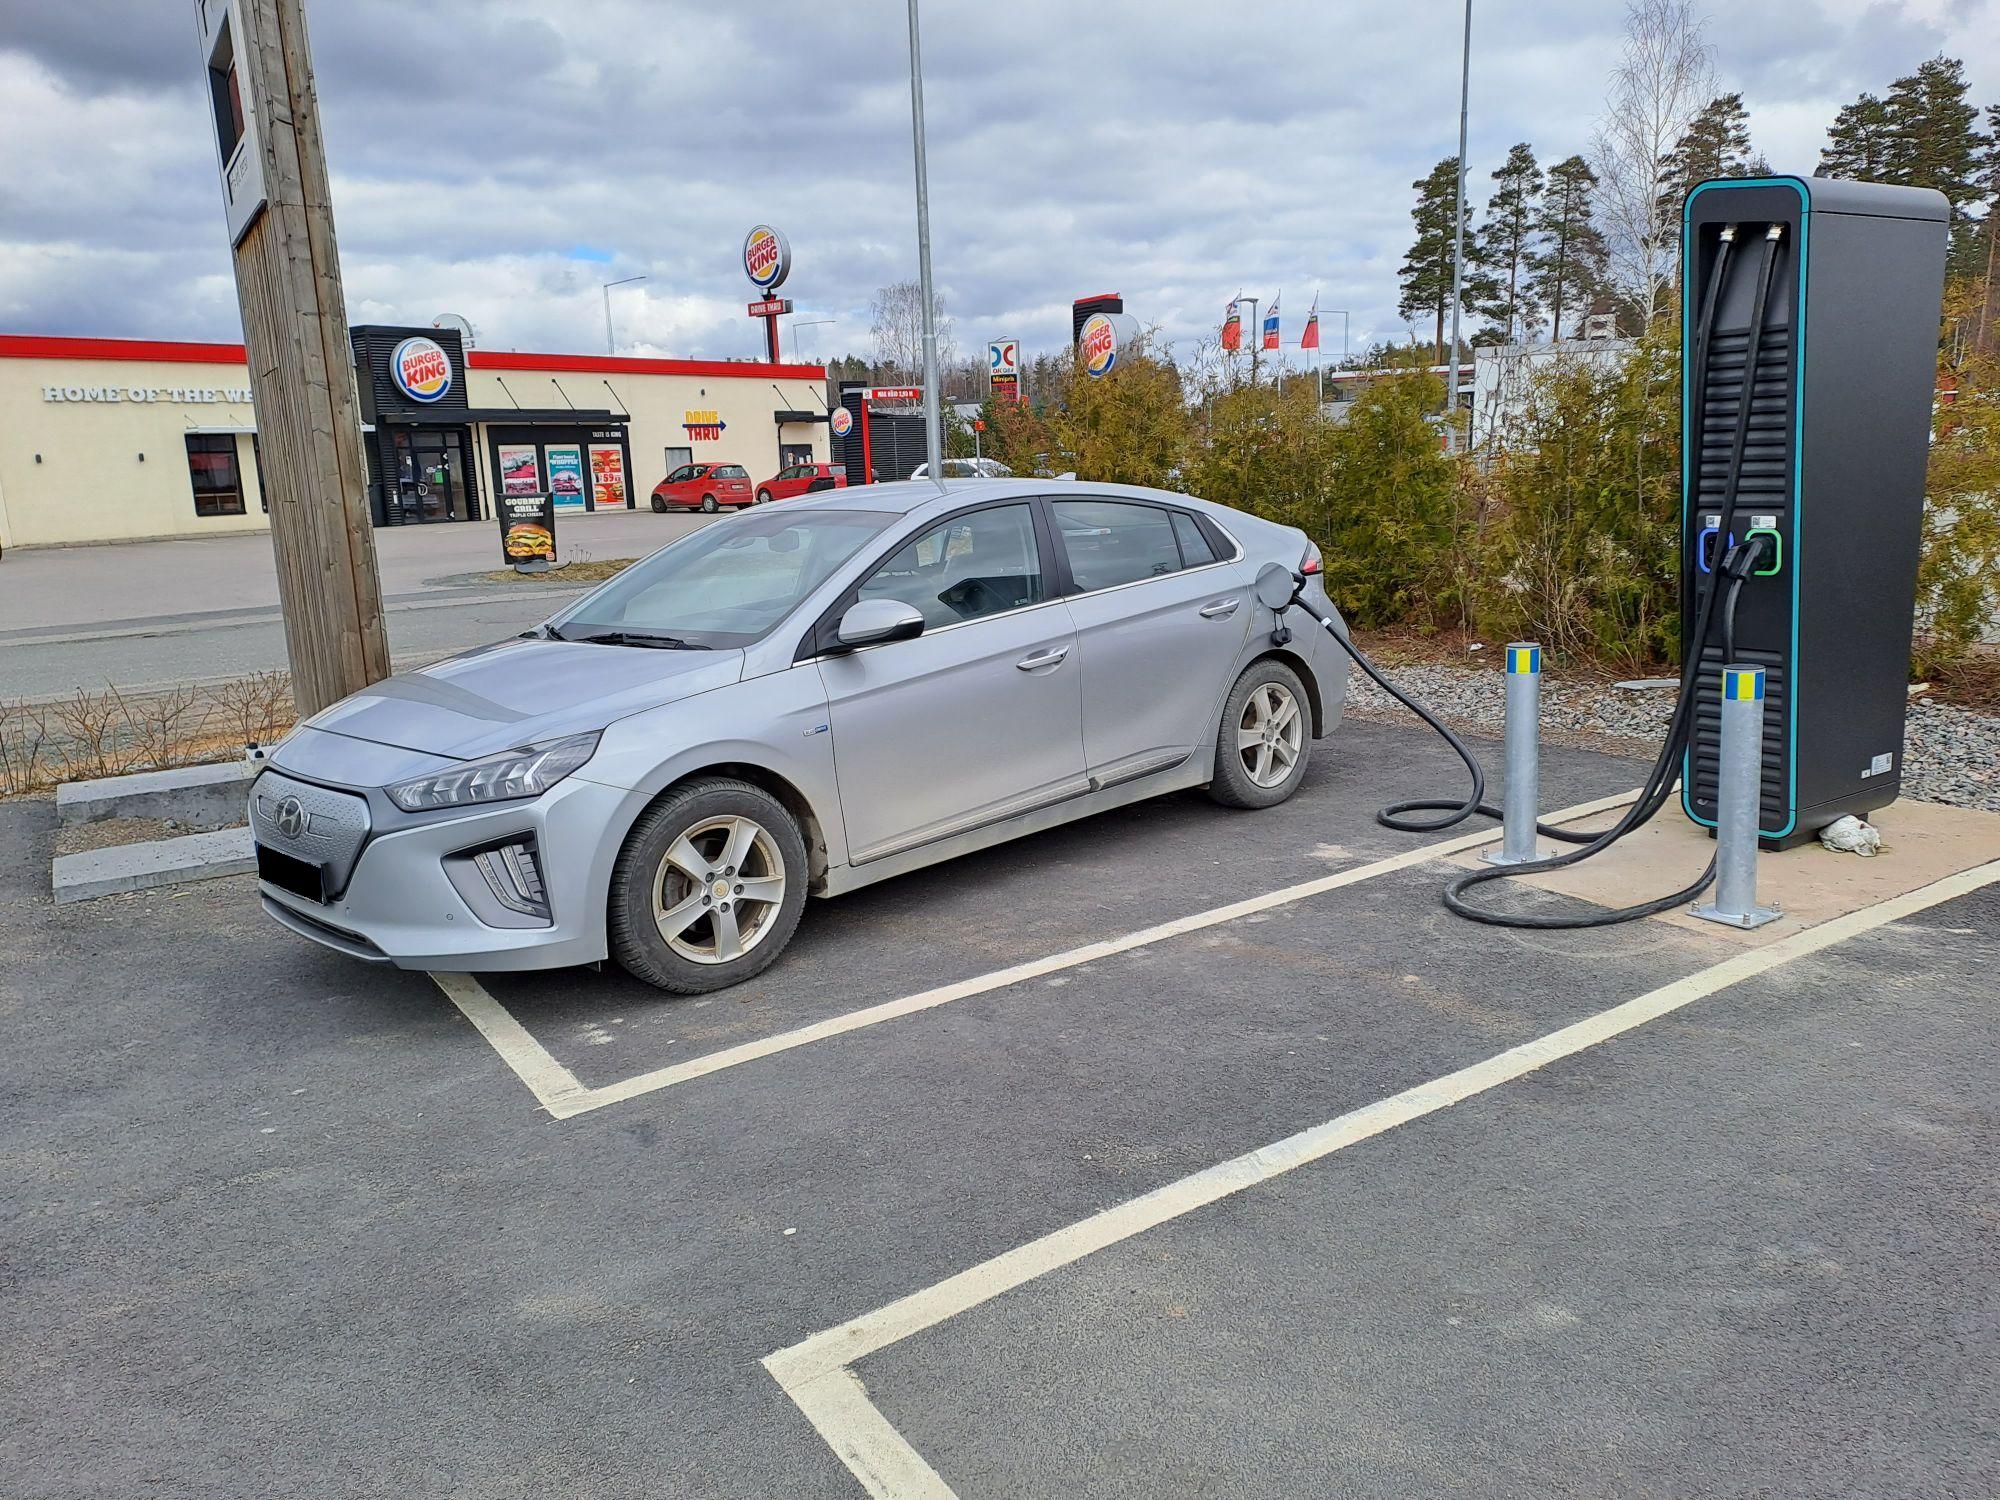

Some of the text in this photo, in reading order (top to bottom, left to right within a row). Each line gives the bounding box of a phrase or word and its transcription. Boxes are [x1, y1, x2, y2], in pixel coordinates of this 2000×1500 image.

[747, 236, 775, 261] BURGER
[749, 246, 777, 275] KING
[750, 304, 767, 314] DRIVE
[1085, 335, 1112, 362] ING
[402, 351, 442, 372] BURGER
[405, 361, 446, 387] KING
[43, 386, 121, 402] HOME
[128, 387, 158, 403] OF
[168, 387, 217, 403] THE
[685, 411, 719, 424] DRIVE
[687, 426, 719, 441] THRU
[505, 498, 545, 506] GOURMET
